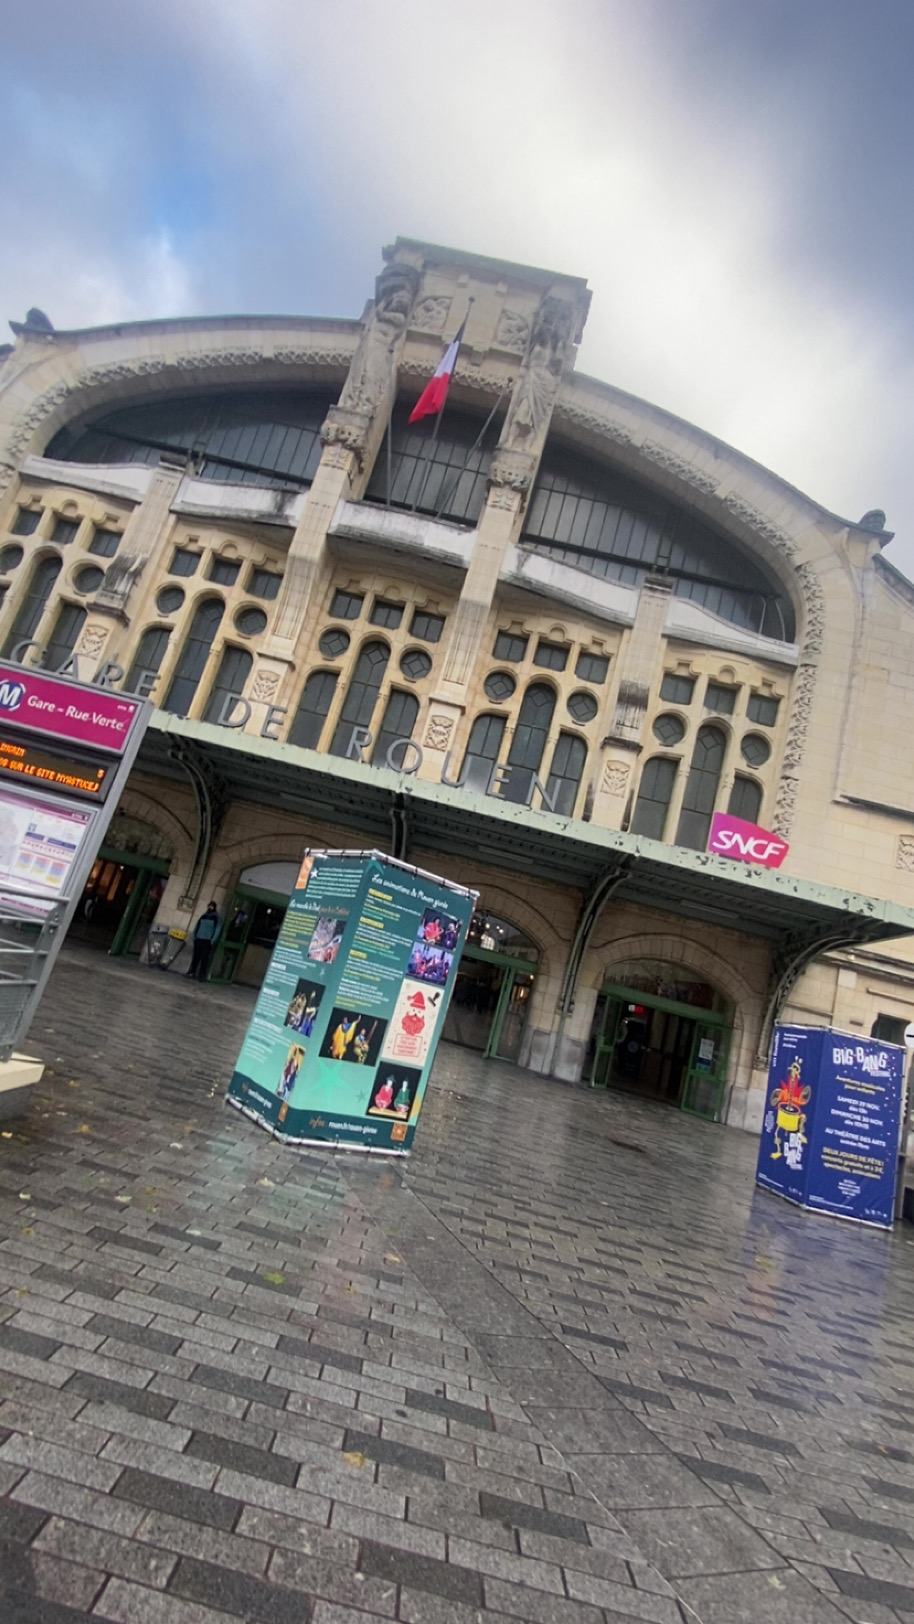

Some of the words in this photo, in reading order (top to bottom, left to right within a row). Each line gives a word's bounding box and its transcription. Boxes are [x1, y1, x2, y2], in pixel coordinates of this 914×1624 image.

[8, 639, 161, 697] GARE
[217, 691, 288, 739] DE
[345, 726, 562, 812] ROUEN
[27, 695, 56, 713] Gare
[65, 705, 90, 721] Rue
[91, 712, 125, 731] Verte
[10, 760, 24, 772] SUR
[24, 764, 37, 775] LE
[36, 767, 56, 781] SITE
[712, 830, 786, 860] SNCF
[832, 1047, 854, 1066] BIG
[856, 1046, 889, 1073] BANG
[871, 1138, 887, 1148] ARTS
